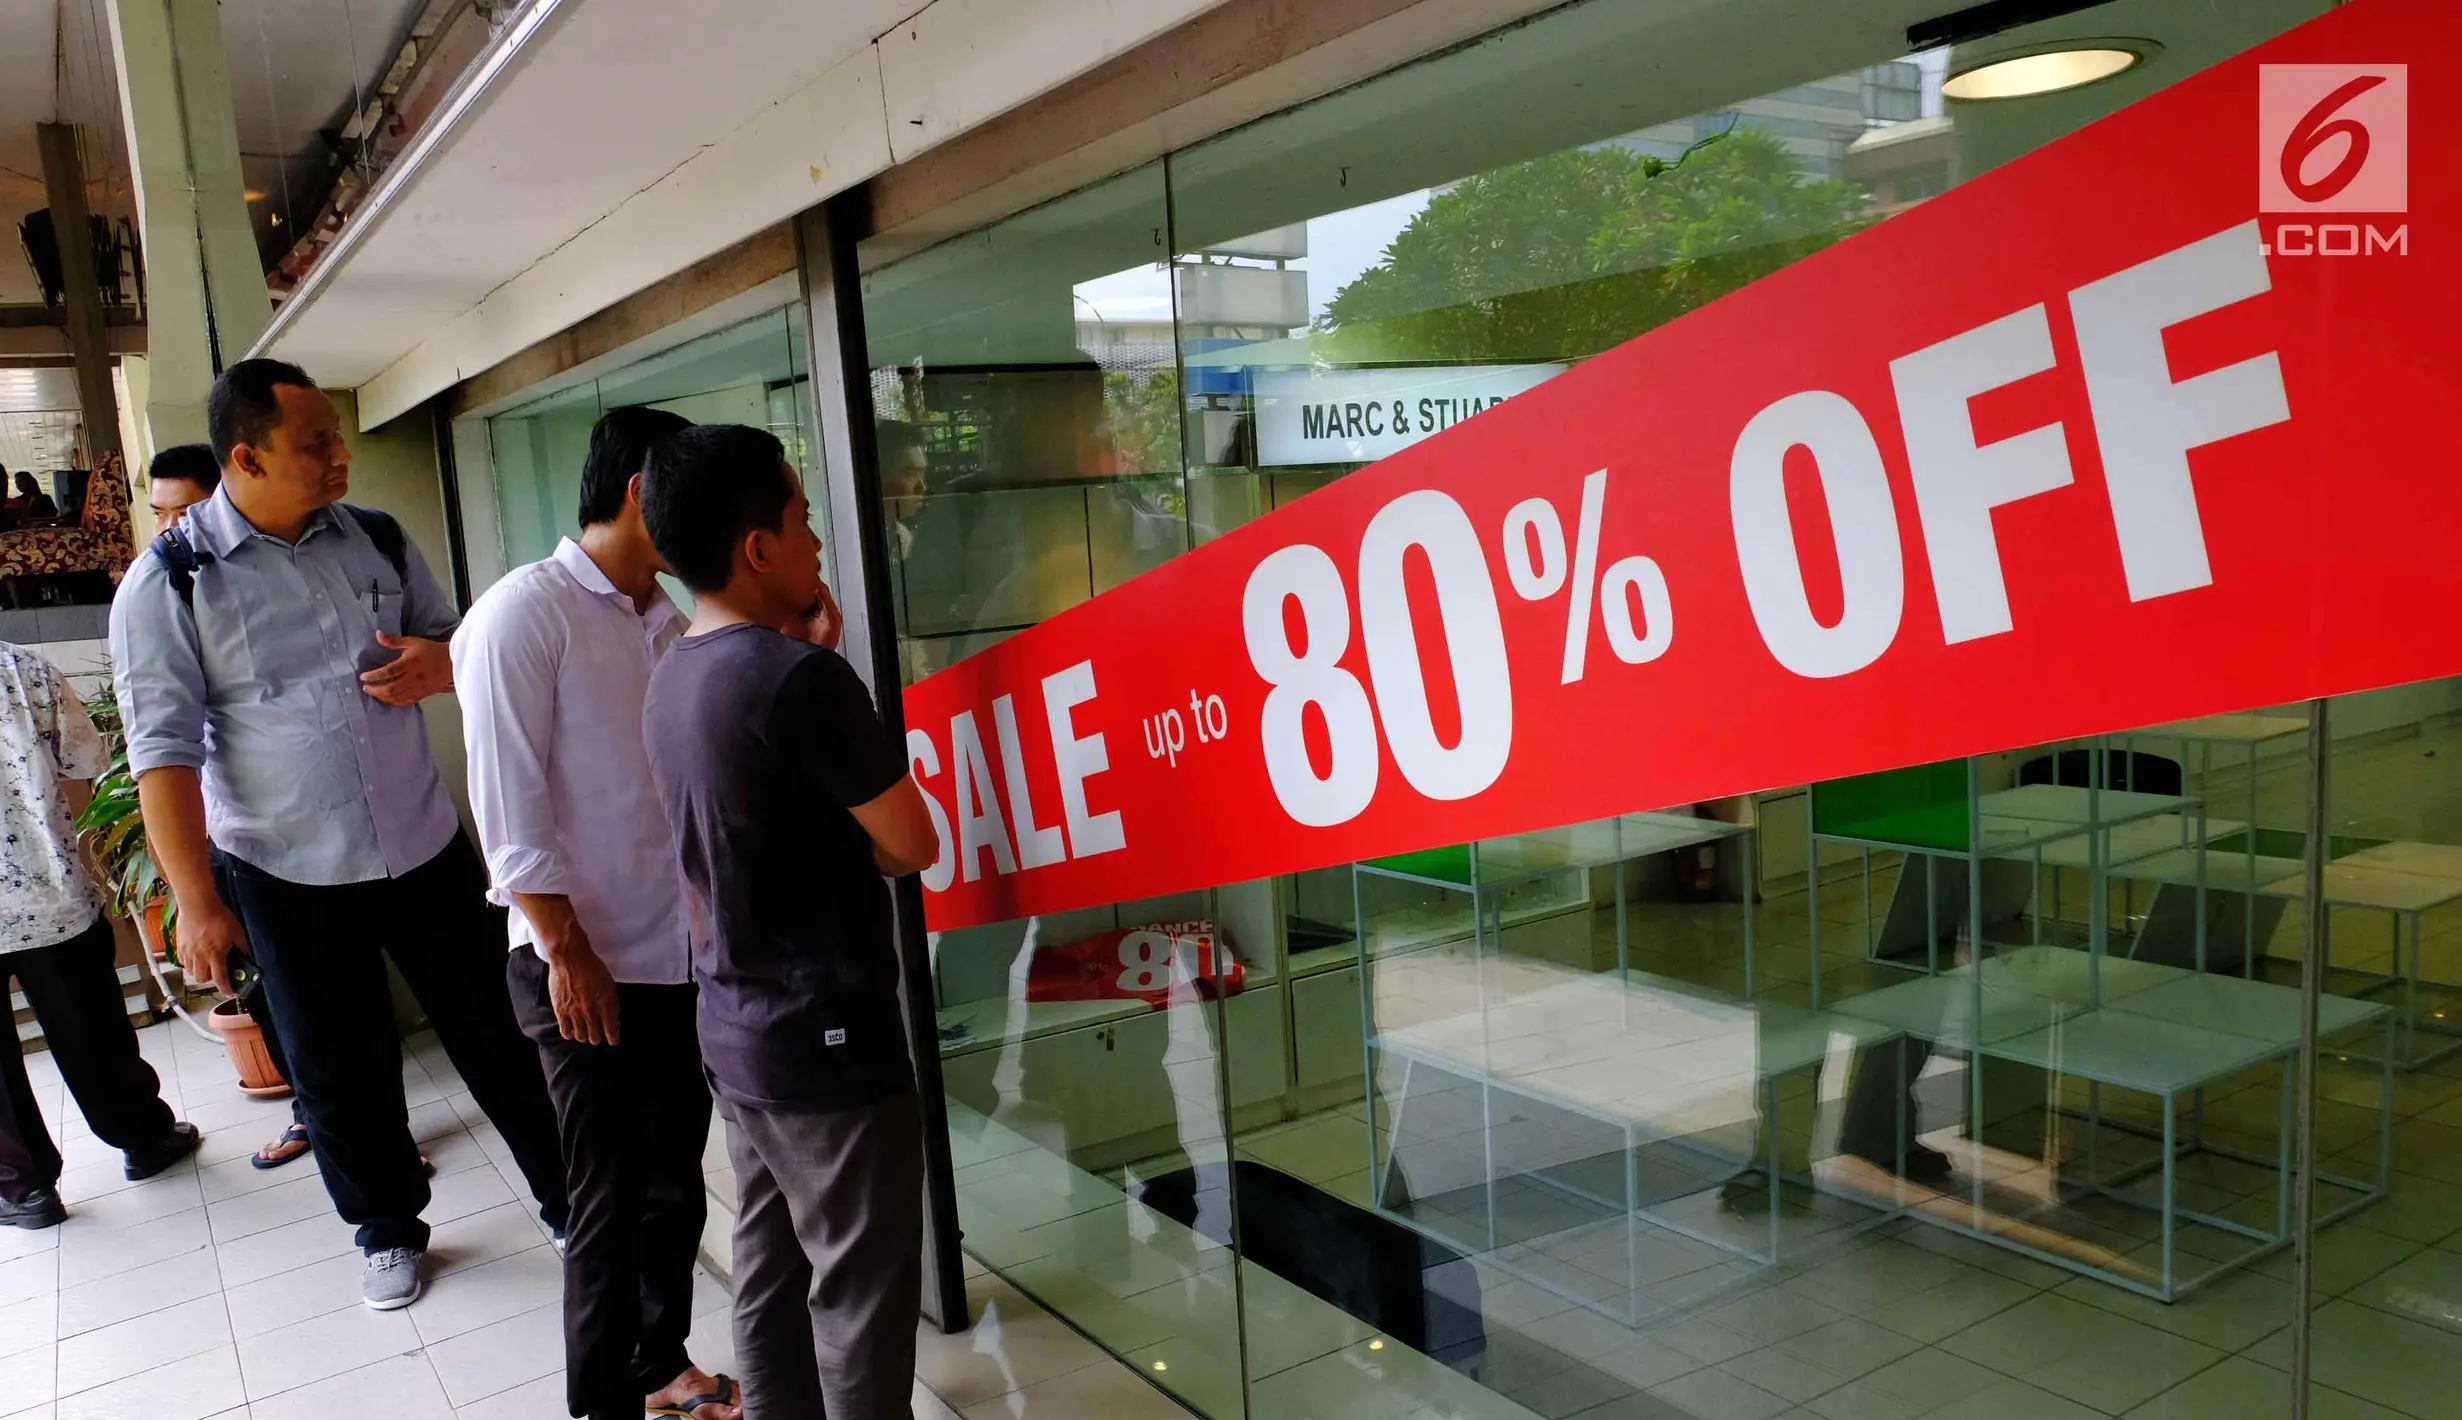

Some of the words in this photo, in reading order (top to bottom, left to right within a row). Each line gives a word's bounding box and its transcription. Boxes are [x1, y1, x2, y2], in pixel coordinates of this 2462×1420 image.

[906, 659, 1127, 892] SALE
[1143, 708, 1185, 768] up
[1190, 688, 1228, 743] to
[1242, 468, 1673, 827] 80%
[1730, 218, 2291, 678] OFF
[1302, 401, 1384, 439] MARC
[1392, 400, 1410, 434] &
